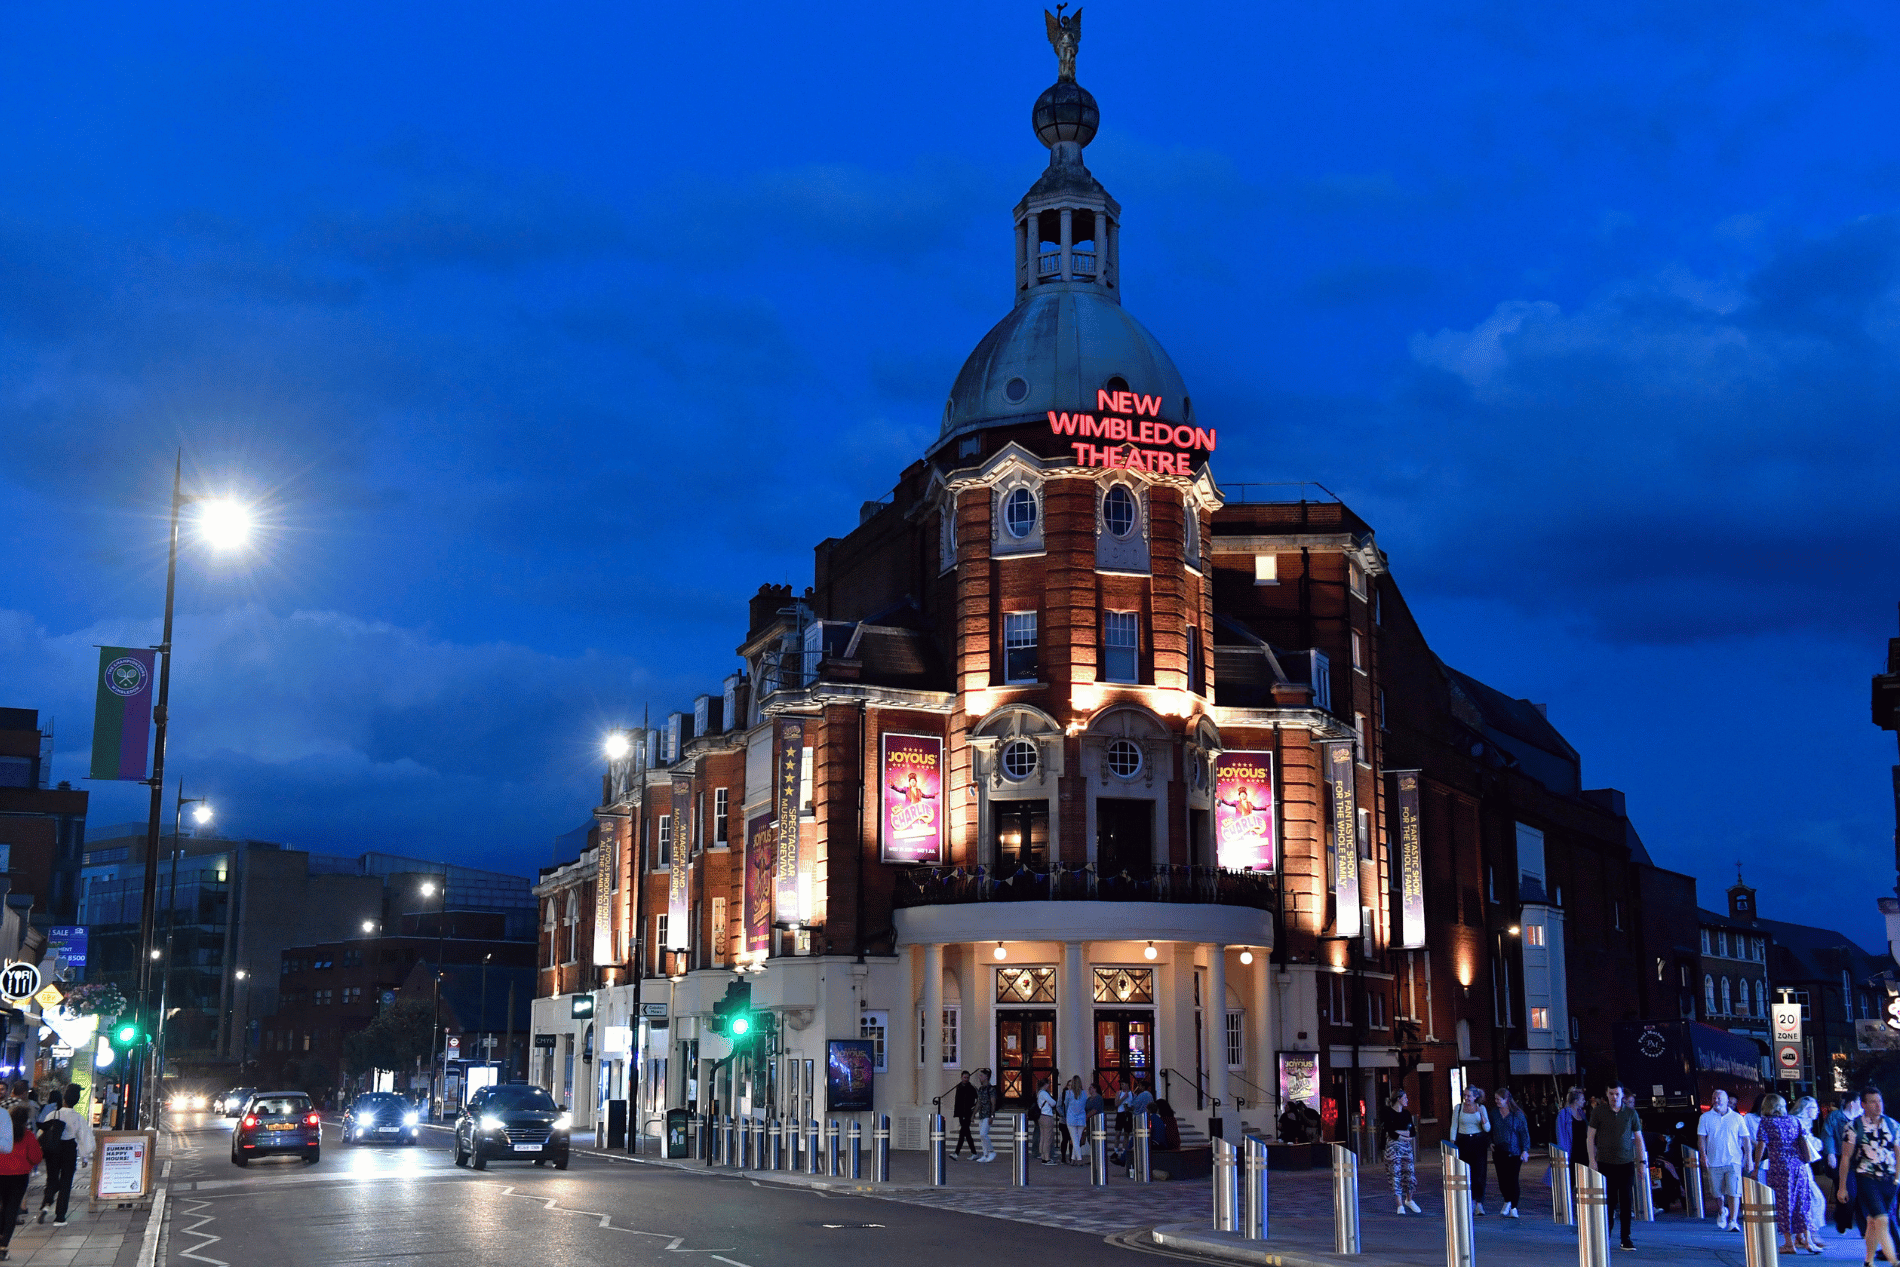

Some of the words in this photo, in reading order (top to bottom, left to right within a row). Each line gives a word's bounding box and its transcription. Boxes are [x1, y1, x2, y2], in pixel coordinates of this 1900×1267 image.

[1097, 389, 1163, 417] NEW
[1048, 411, 1217, 451] WIMBLEDON
[1071, 442, 1191, 476] THEATRE
[112, 685, 140, 695] WIMBLEDON
[888, 751, 937, 765] 'JOYOUS'
[1335, 780, 1343, 799] FOR
[892, 803, 931, 828] CHARLIE
[1336, 801, 1344, 818] THE
[1223, 816, 1263, 840] CHARLIE
[1337, 820, 1346, 853] WHOLE
[1345, 800, 1353, 848] FANTASTIC
[1411, 824, 1419, 868] FANTASTIC
[1412, 870, 1420, 895] SHOW
[598, 894, 603, 904] TO
[603, 873, 611, 919] PRODUCTION
[1779, 1014, 1795, 1024] 20
